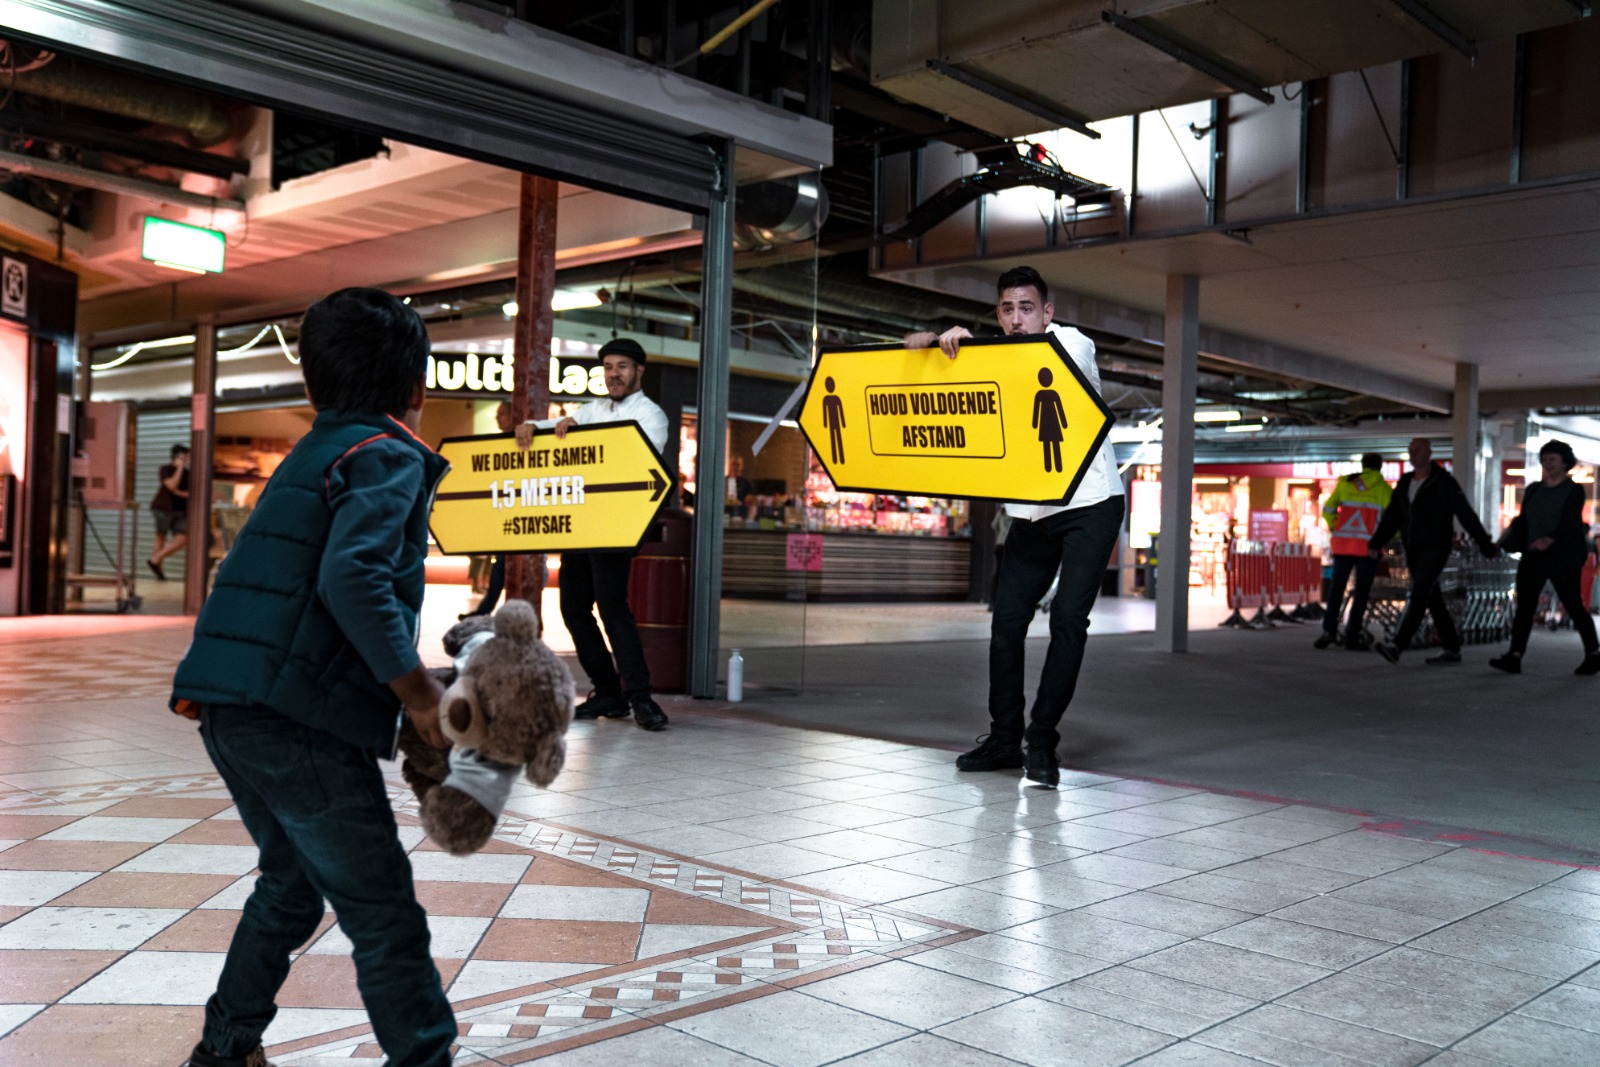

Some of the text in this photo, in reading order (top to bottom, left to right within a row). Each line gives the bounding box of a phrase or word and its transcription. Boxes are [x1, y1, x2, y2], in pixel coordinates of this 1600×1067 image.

[869, 391, 997, 415] HOUD VOLDOENDE
[902, 425, 966, 448] AFSTAND
[471, 445, 604, 472] WE DOEN HET SAMEN !
[489, 475, 585, 510] 1,5 METER
[503, 515, 572, 535] #STAYSAFE
